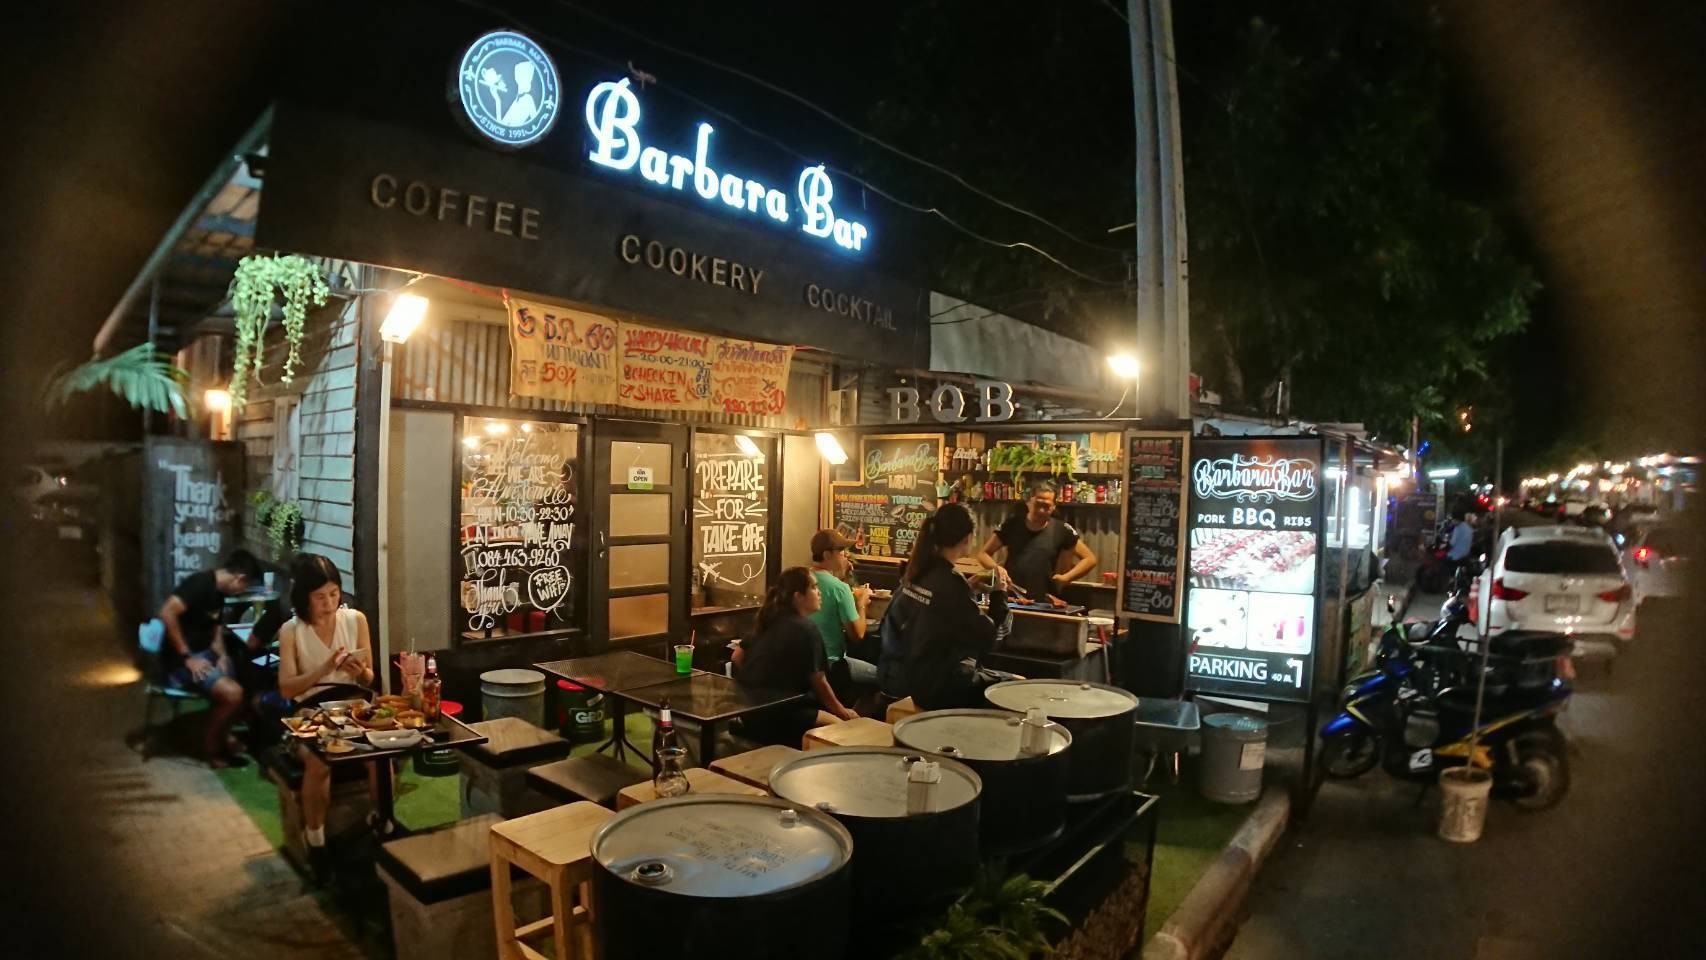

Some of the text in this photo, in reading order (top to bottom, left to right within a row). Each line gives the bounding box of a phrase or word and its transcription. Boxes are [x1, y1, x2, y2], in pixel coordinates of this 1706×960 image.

[480, 116, 527, 139] SINCE 1991
[586, 76, 869, 252] Barbara Bar
[371, 173, 541, 241] COFFEE
[620, 234, 765, 294] COOKERY
[807, 284, 898, 331] COCKTAIL
[586, 322, 615, 351] 60
[541, 361, 577, 387] 50%
[633, 384, 682, 404] SHARE
[696, 458, 765, 491] PREPARE
[888, 474, 917, 490] MENU
[1194, 453, 1316, 498] Barbara Bar
[175, 502, 208, 523] you
[715, 499, 746, 520] FOR
[1198, 507, 1312, 529] PORK BBQ RIBS
[174, 522, 221, 554] being
[701, 523, 765, 554] TAKE-OFF
[171, 546, 201, 570] the
[478, 548, 560, 568] 084-463-9260
[533, 568, 563, 587] FREE
[1151, 590, 1173, 609] 80
[1189, 656, 1268, 681] PARKING
[1271, 673, 1283, 682] 40
